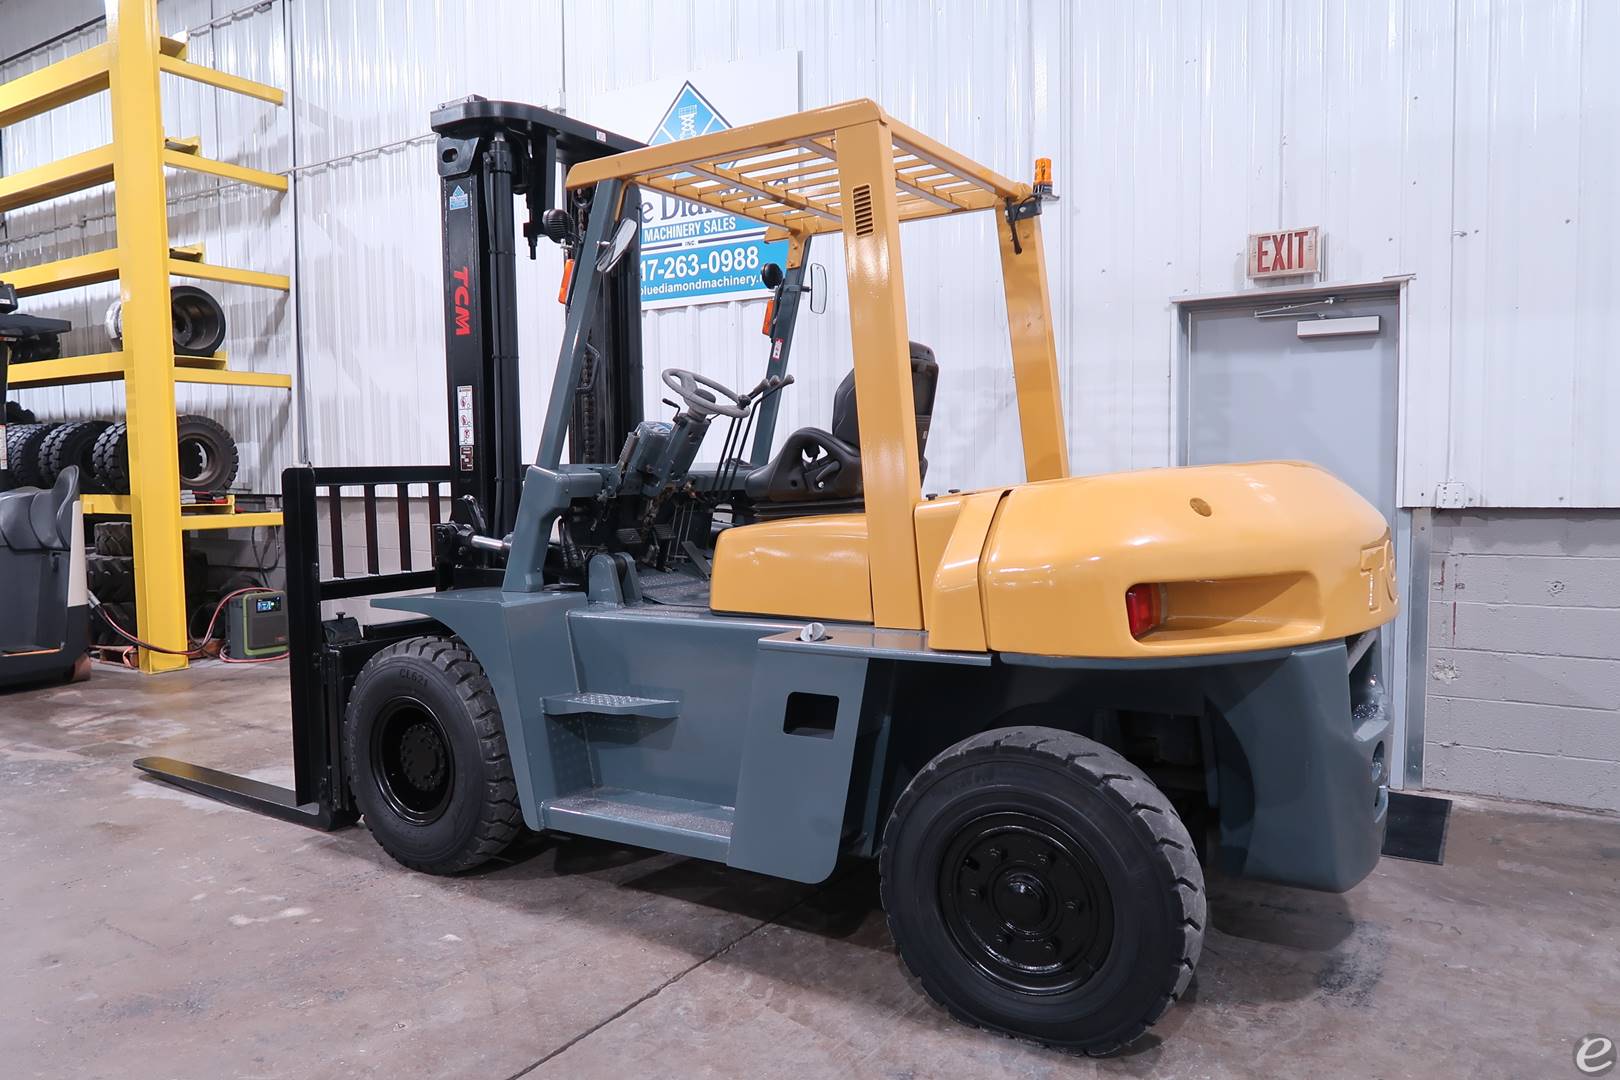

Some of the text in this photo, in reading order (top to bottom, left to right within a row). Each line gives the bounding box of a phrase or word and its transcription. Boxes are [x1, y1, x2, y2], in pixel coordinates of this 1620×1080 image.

[644, 216, 736, 242] MACHINERY SALES
[640, 246, 759, 281] 17-263-0988
[1257, 231, 1309, 273] EXIT
[453, 266, 470, 335] TCM
[640, 273, 763, 297] luediamondmachinery.
